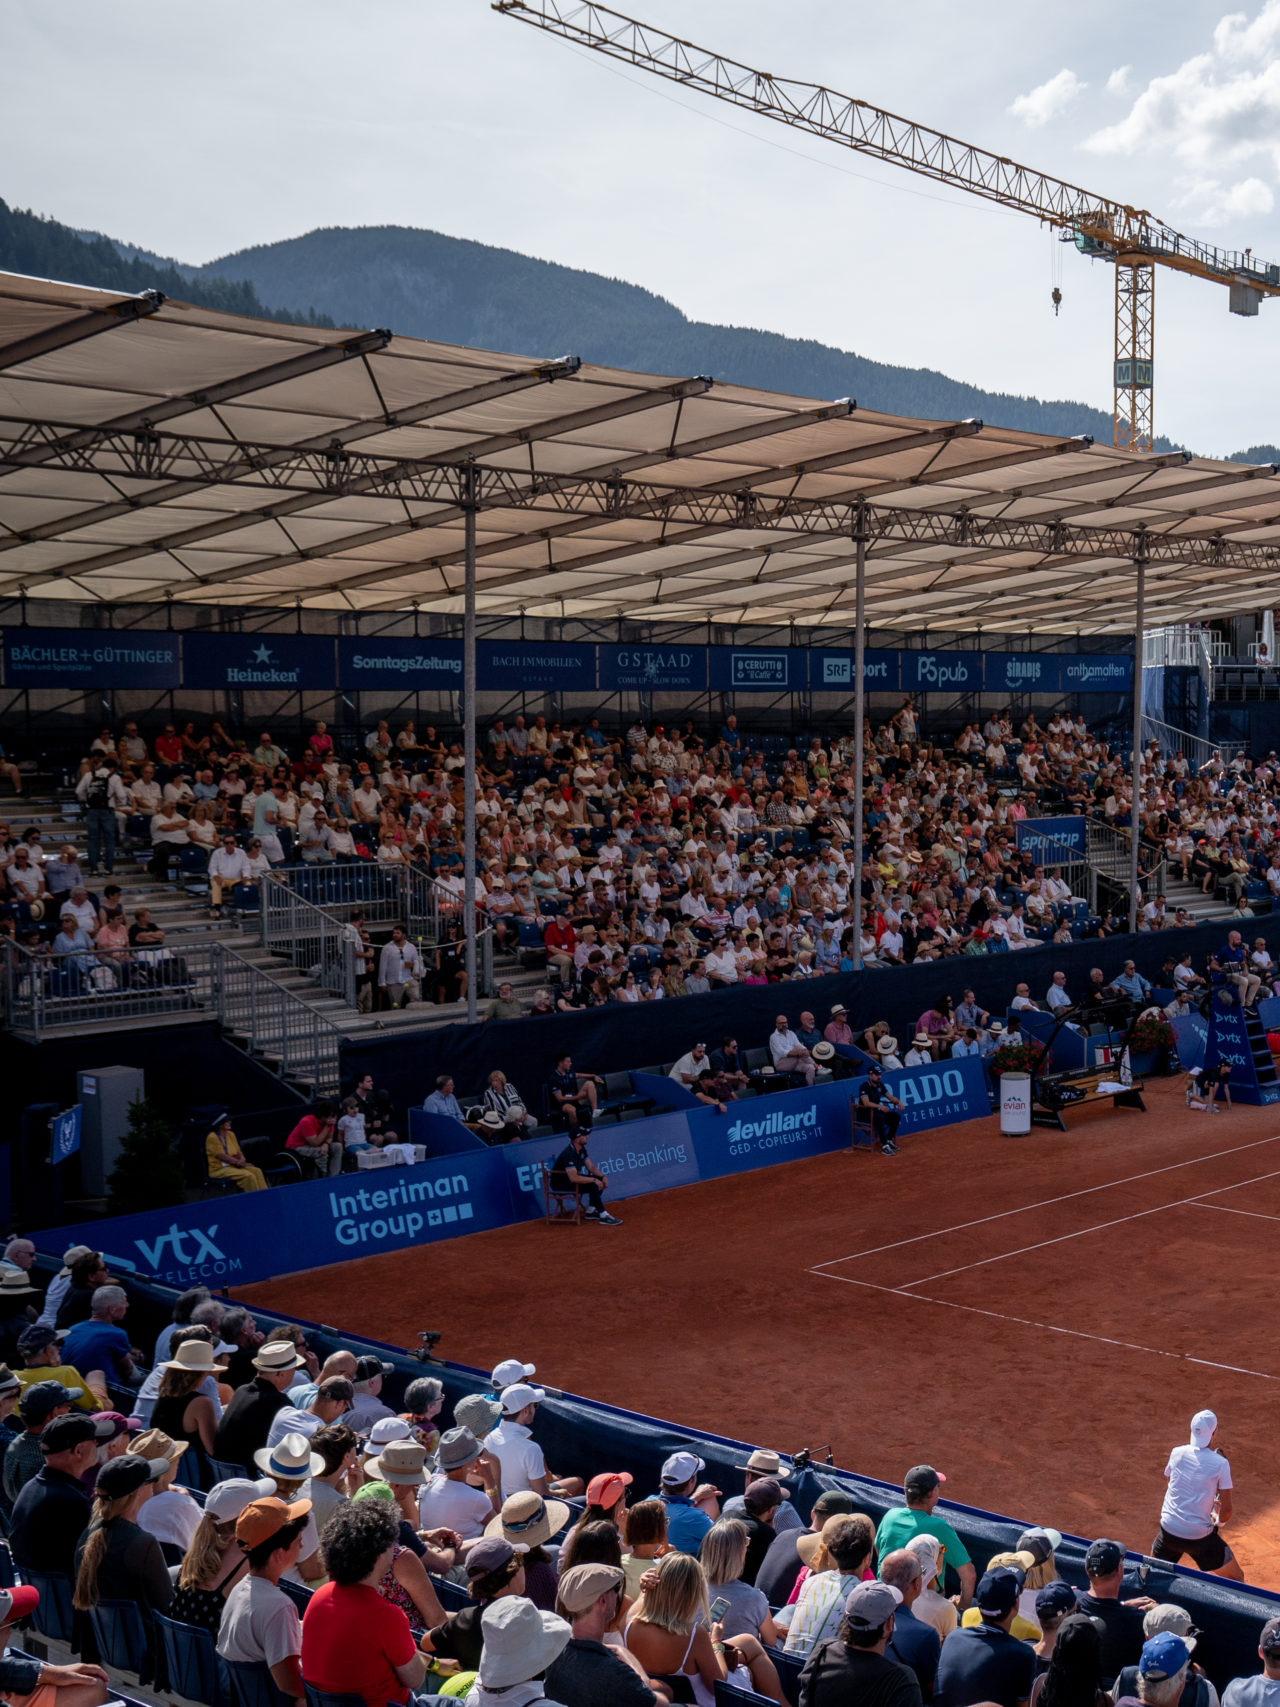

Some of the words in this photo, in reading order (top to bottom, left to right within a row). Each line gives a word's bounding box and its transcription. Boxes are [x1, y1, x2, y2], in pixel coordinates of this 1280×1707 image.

[353, 656, 462, 673] SonntagsZeitung
[493, 656, 519, 667] BACH
[522, 657, 582, 668] IMMOBILIEN
[617, 652, 691, 668] GSTAAD
[745, 660, 777, 670] CERUTTI
[227, 668, 298, 682] Heineken
[826, 663, 848, 677] SRF
[1223, 1014, 1238, 1024] vtx
[1225, 1032, 1241, 1044] vtx
[903, 1101, 969, 1124] TZERLAND
[1003, 1102, 1026, 1110] evian
[727, 1104, 817, 1143] devillard
[730, 1142, 751, 1155] GED
[758, 1129, 807, 1150] COPIEURS
[814, 1126, 823, 1138] IT
[626, 1143, 688, 1171] Banking
[330, 1174, 469, 1218] Interiman
[335, 1212, 423, 1245] Group
[134, 1223, 226, 1271] vtx
